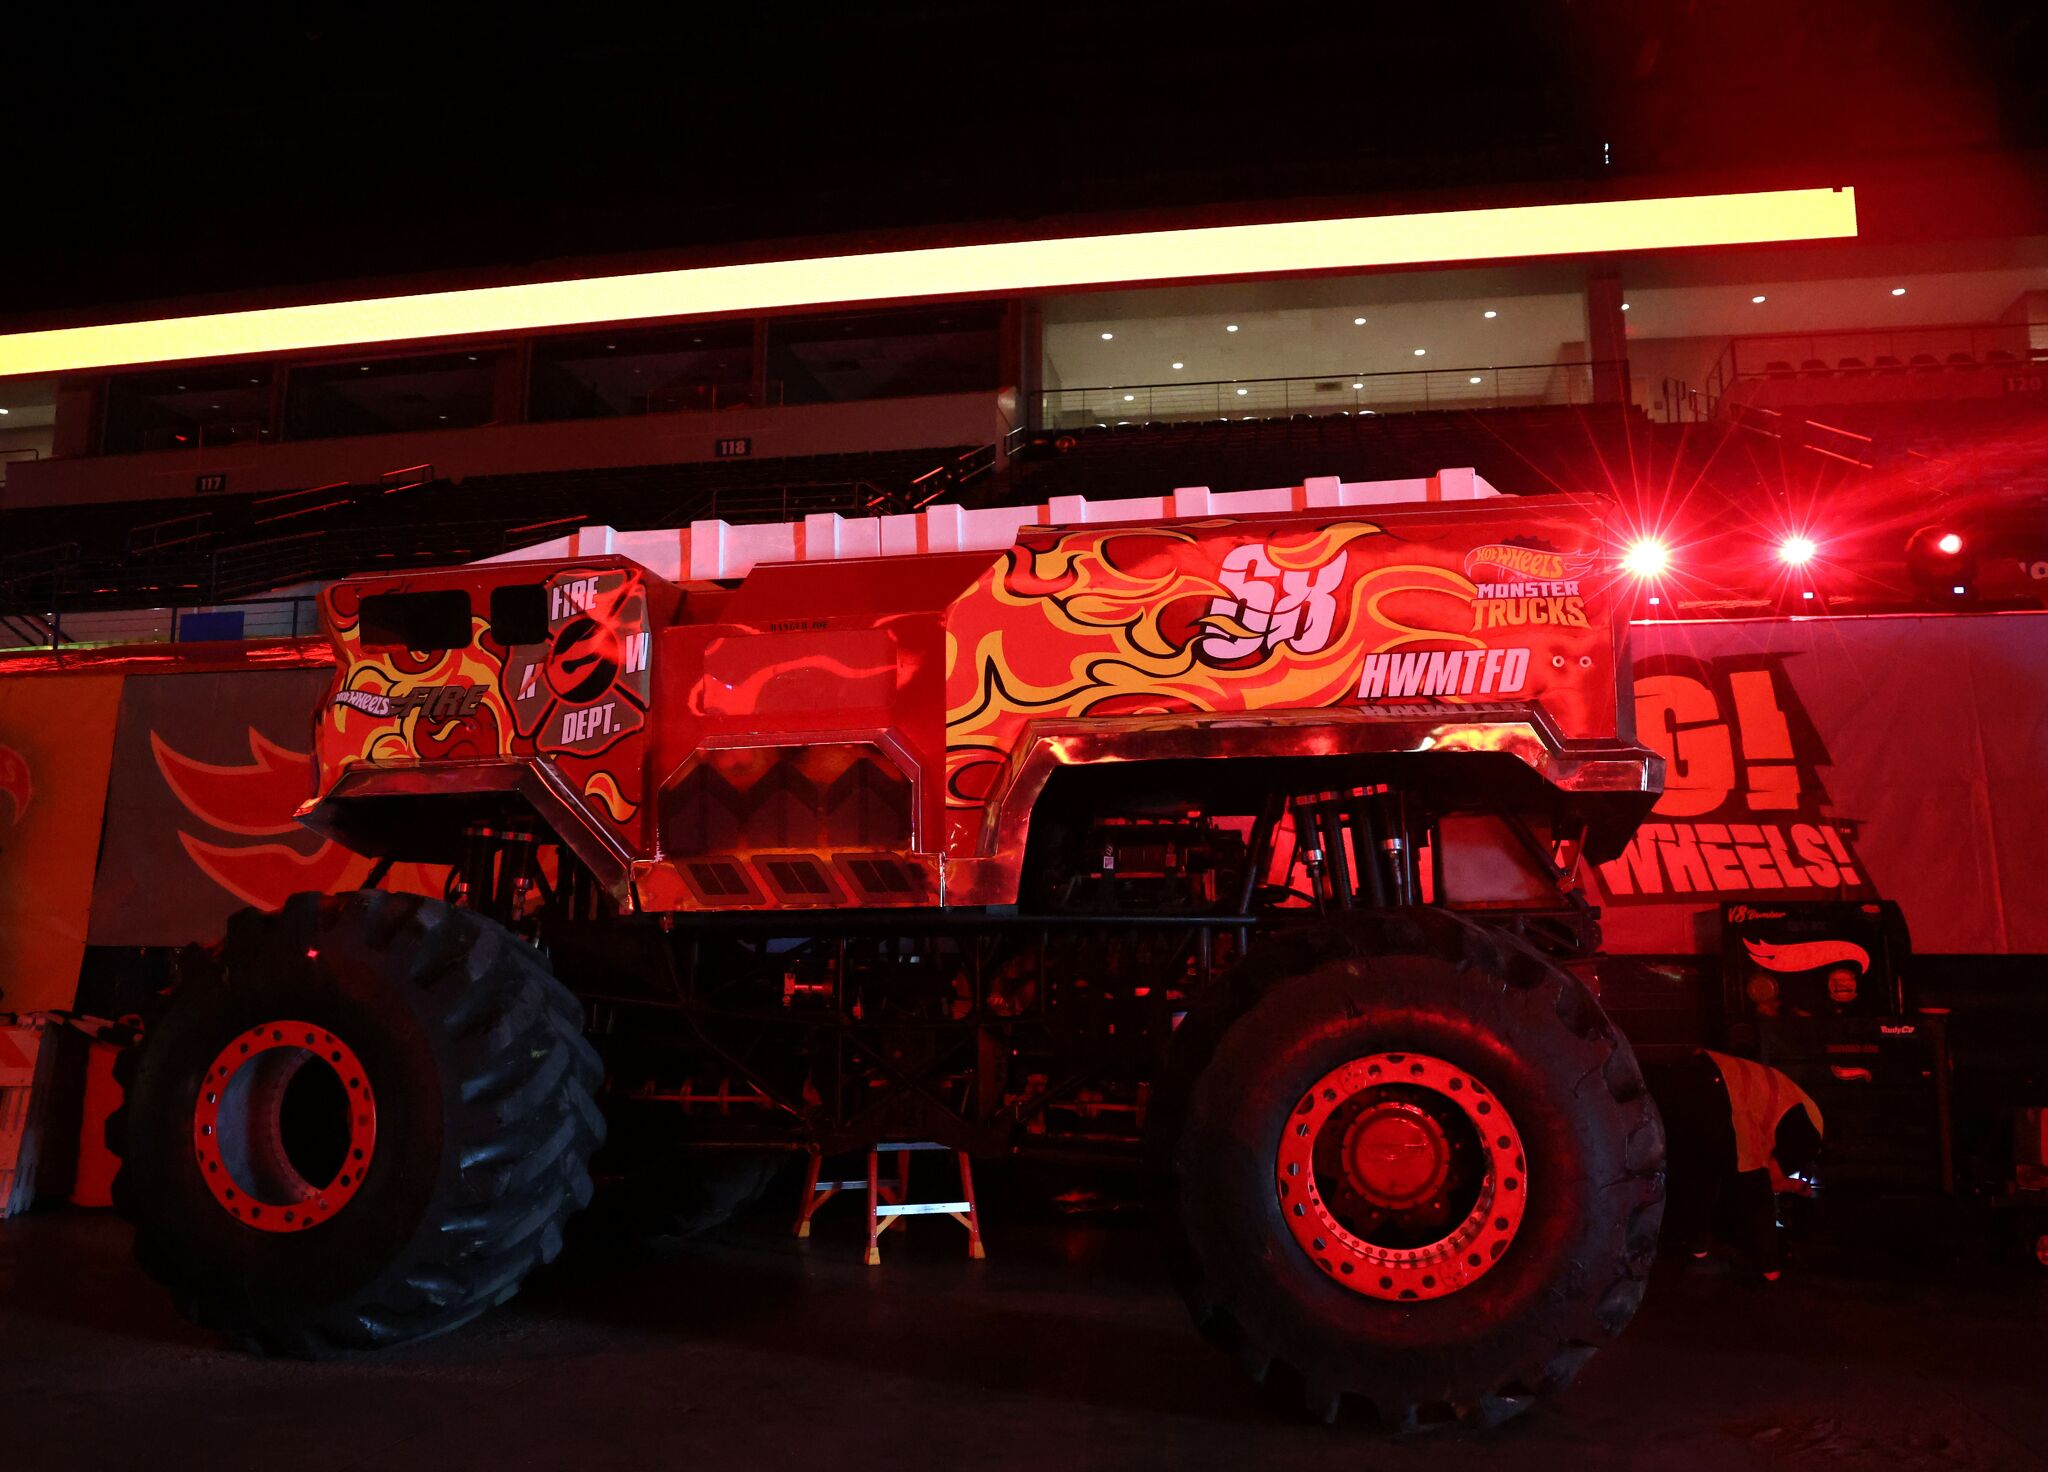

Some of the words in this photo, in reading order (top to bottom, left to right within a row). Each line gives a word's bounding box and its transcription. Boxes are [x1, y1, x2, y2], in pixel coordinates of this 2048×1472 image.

[720, 440, 746, 456] 118
[200, 476, 222, 491] 117
[551, 576, 599, 621] FIRE
[1475, 580, 1580, 599] MONSTER
[1470, 596, 1593, 633] TRUCKS
[1357, 648, 1531, 698] HWMTFD
[404, 685, 491, 717] FIRE
[561, 702, 621, 745] DEPT.
[1599, 823, 1862, 895] WHEELS!
